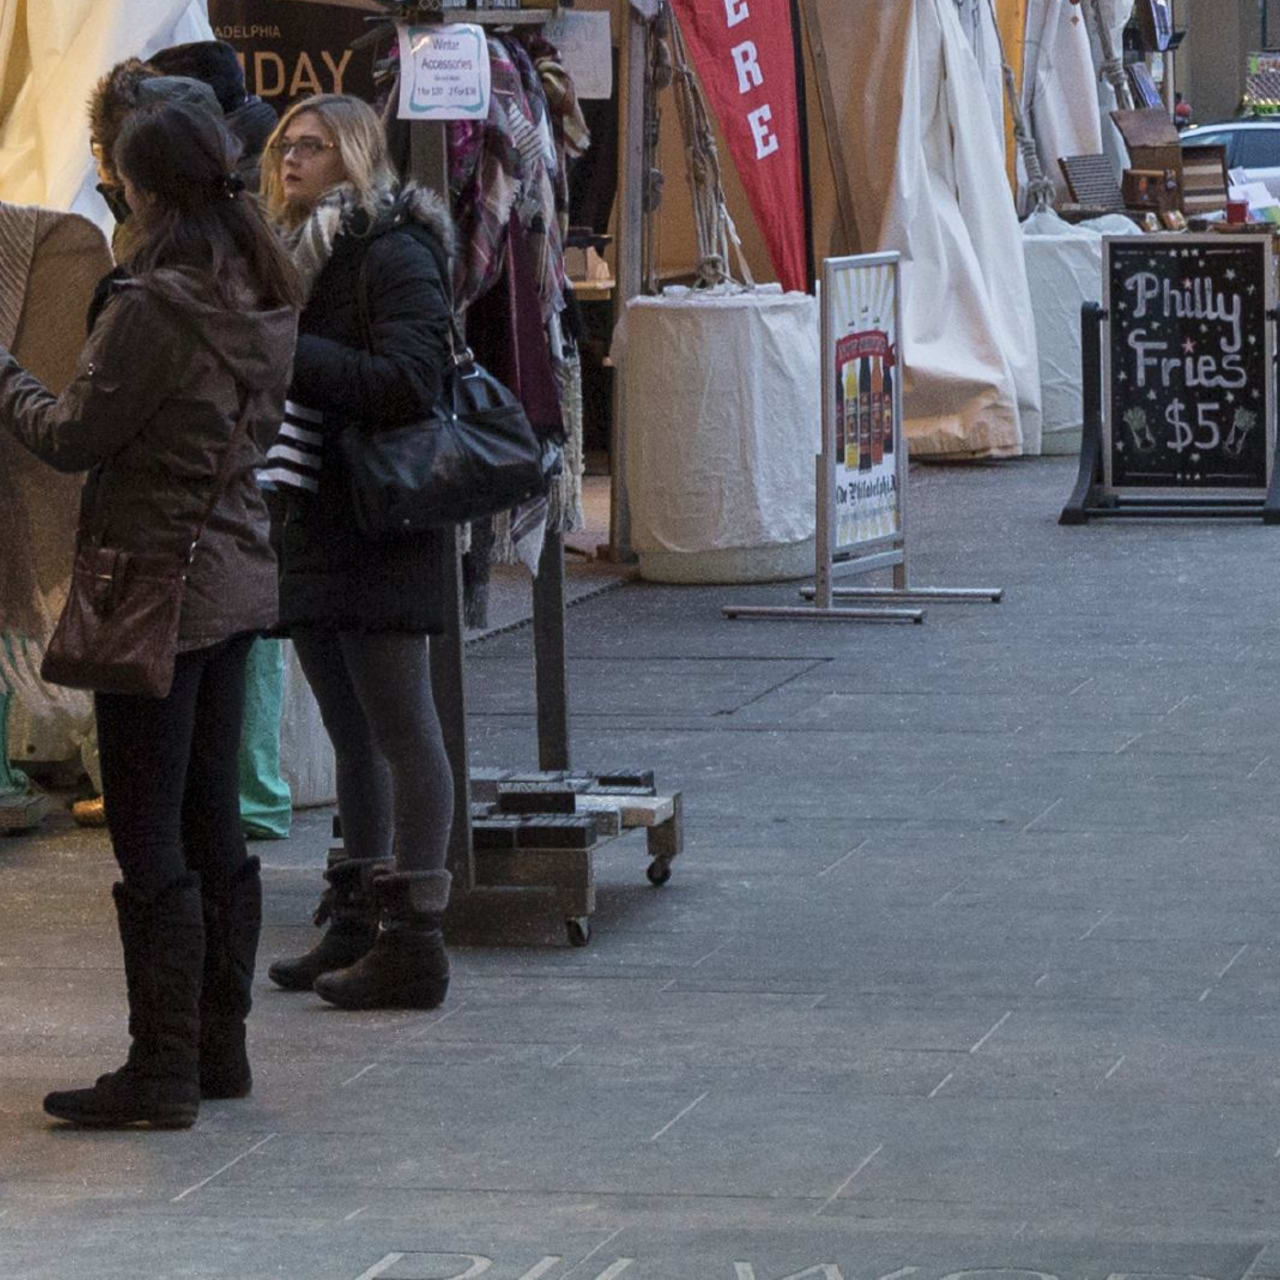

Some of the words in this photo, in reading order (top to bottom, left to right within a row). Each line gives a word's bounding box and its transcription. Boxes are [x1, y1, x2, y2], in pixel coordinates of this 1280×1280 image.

[421, 58, 473, 71] Accessories
[1124, 271, 1242, 354] Philly
[1127, 328, 1248, 389] Fries
[1164, 397, 1221, 454] $5
